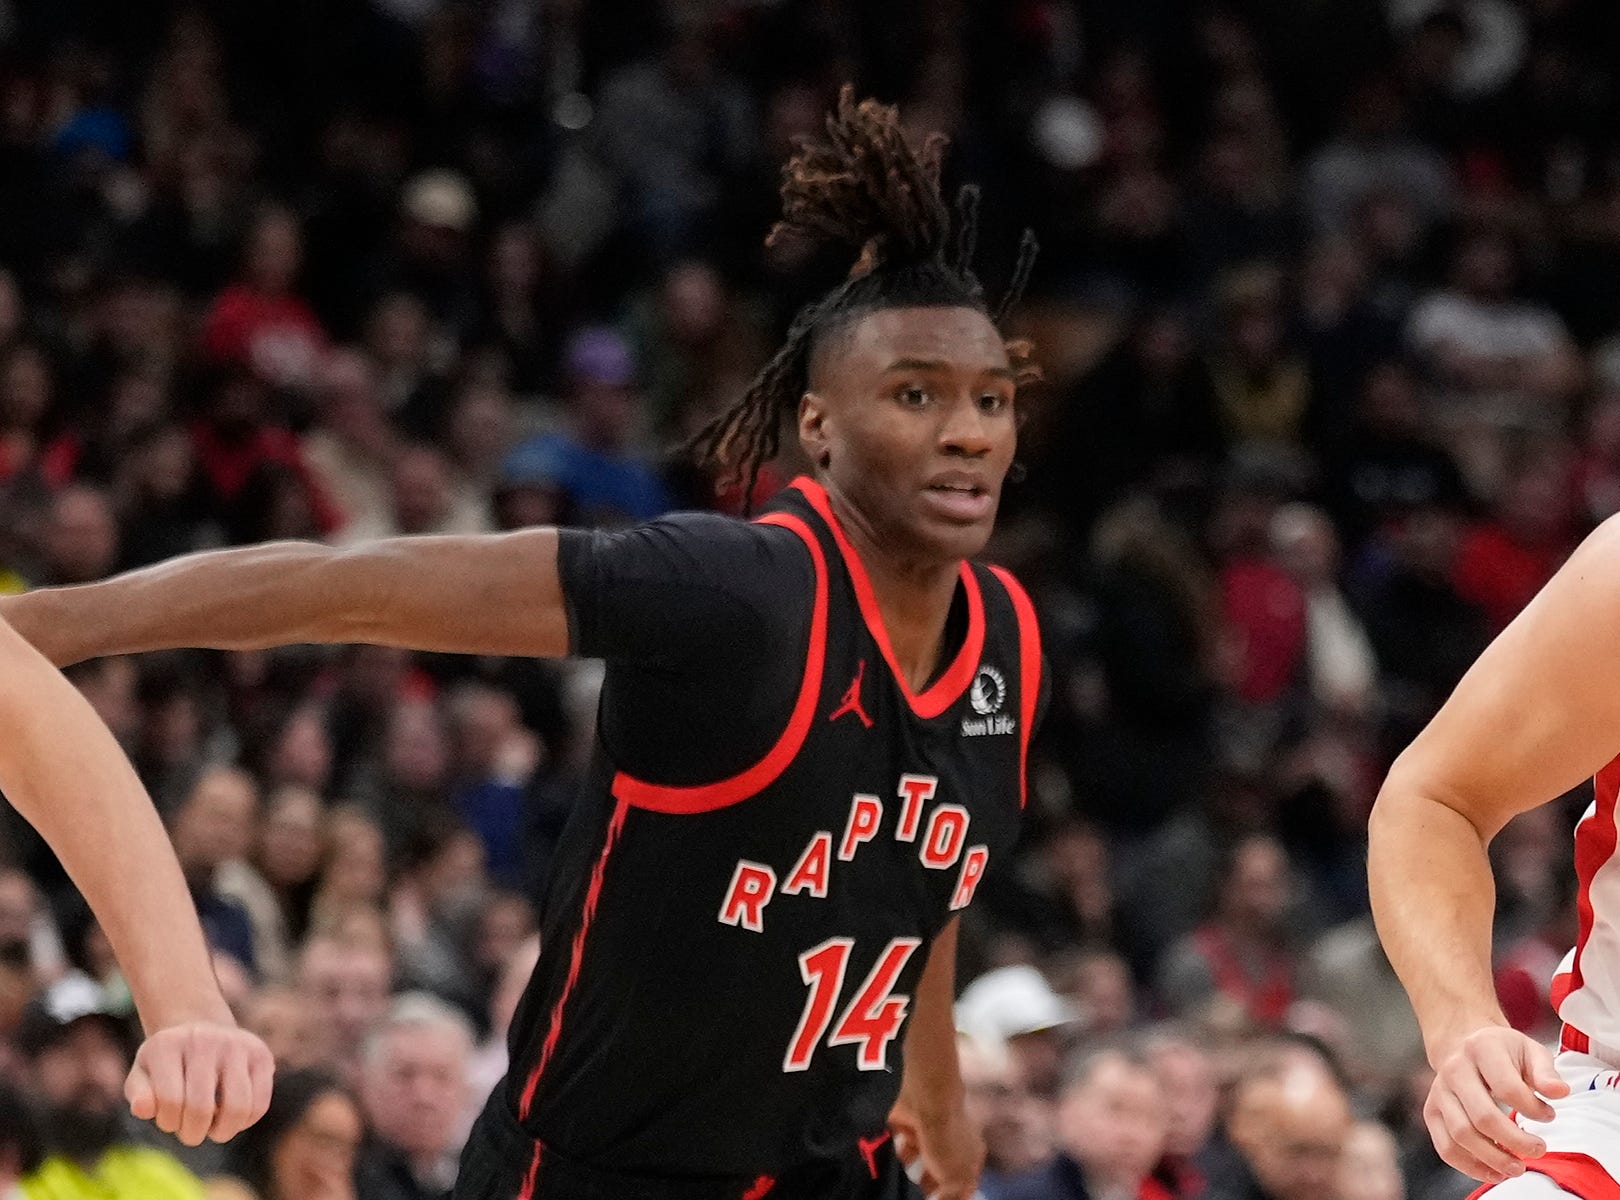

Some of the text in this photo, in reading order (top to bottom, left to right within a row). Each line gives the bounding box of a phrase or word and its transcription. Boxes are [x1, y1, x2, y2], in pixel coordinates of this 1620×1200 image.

[961, 715, 1016, 737] Sun Life
[718, 774, 989, 933] RAPTOR
[783, 937, 922, 1073] 14
